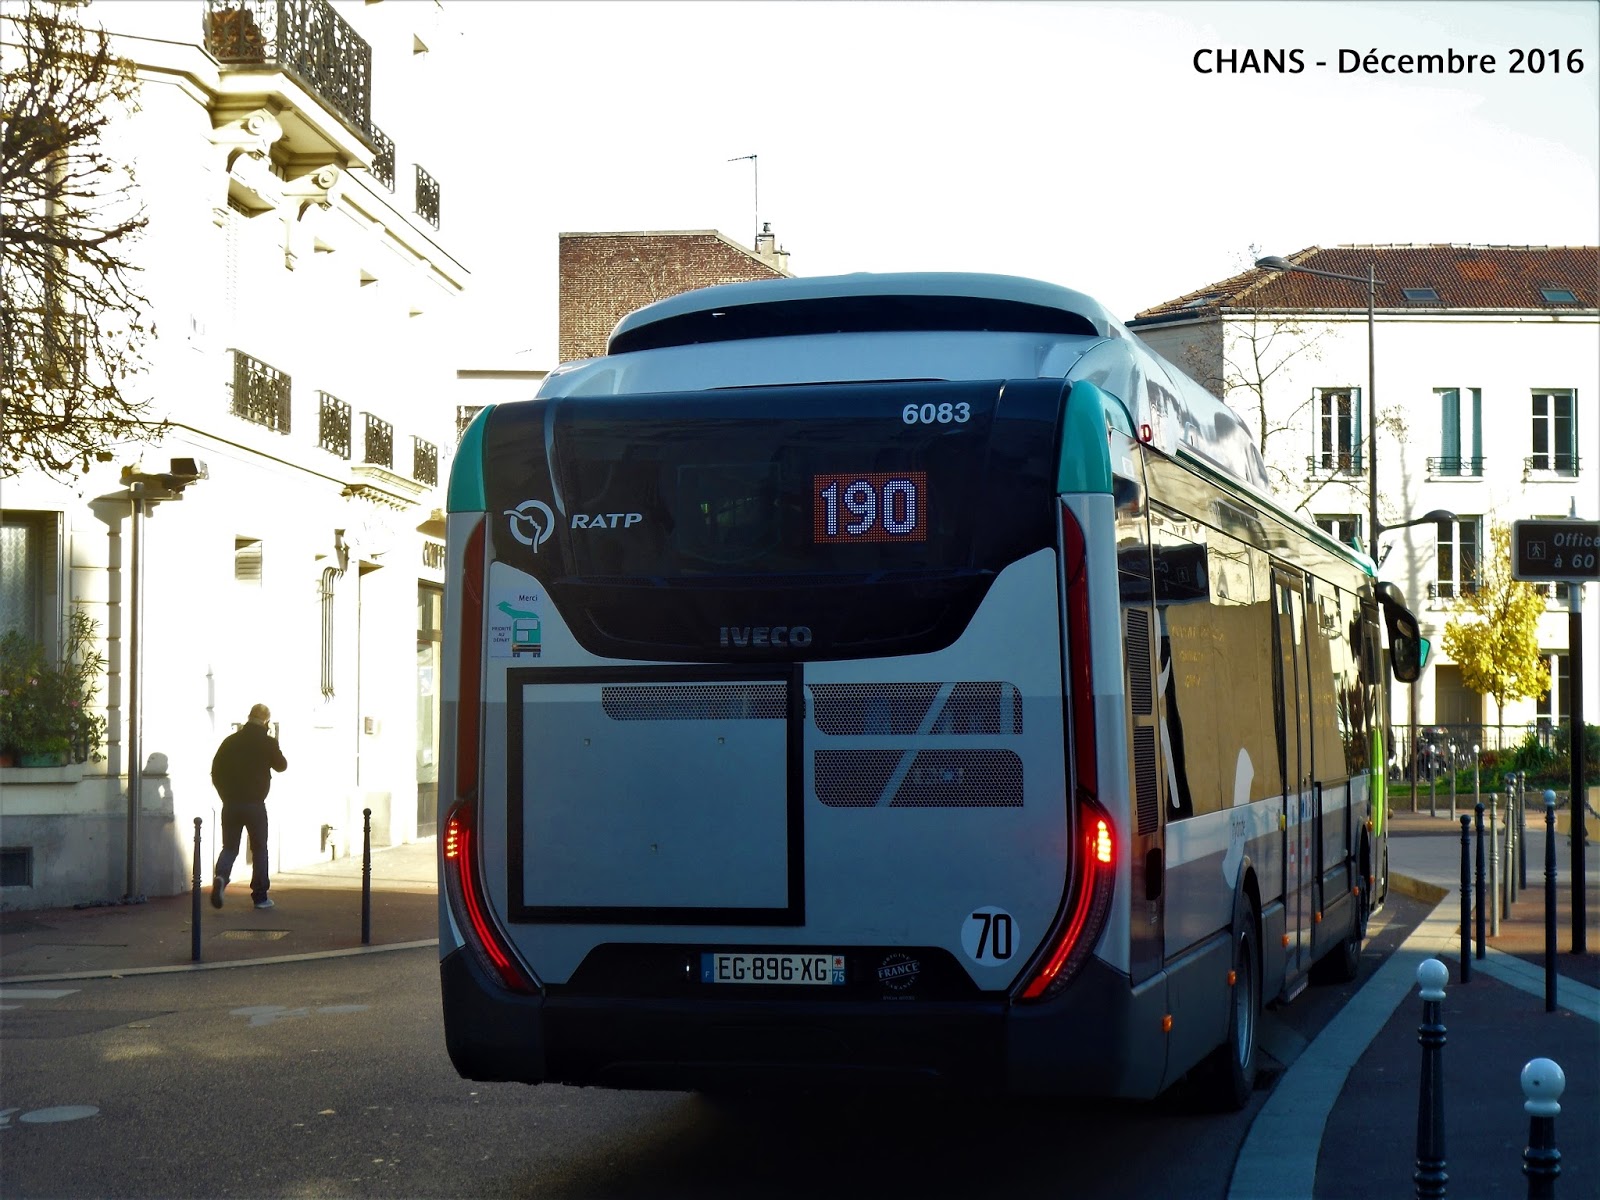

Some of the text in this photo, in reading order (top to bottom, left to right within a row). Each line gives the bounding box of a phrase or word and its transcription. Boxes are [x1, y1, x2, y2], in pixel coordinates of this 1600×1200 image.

[902, 402, 970, 425] 6083
[821, 480, 916, 535] 190
[571, 512, 643, 529] RATP
[1554, 553, 1595, 569] à 60
[518, 594, 538, 602] Merci
[720, 626, 813, 648] IVECO
[972, 913, 1012, 960] 70
[705, 956, 846, 983] F EG-896-XG 75
[877, 961, 919, 979] FRANCE
